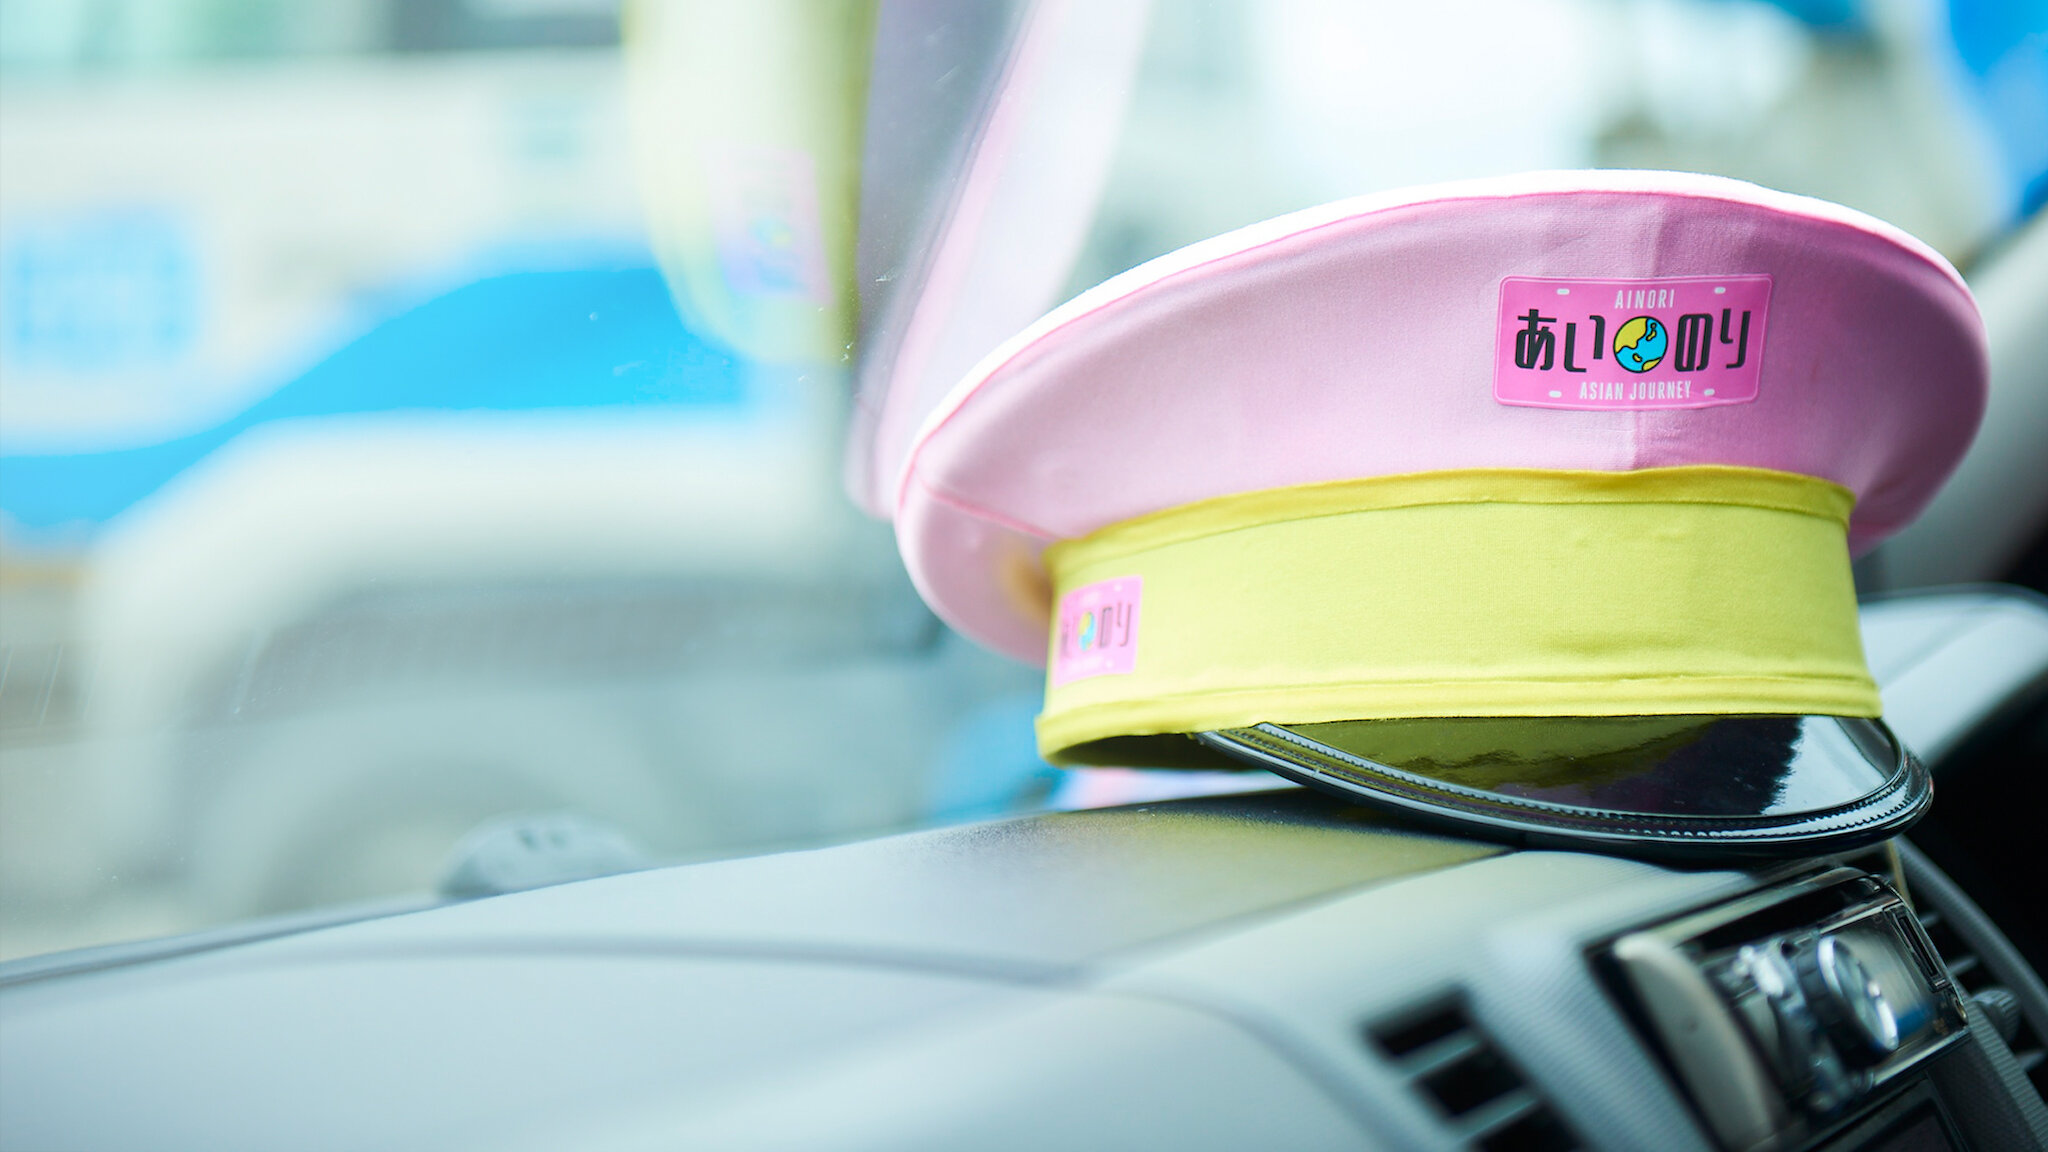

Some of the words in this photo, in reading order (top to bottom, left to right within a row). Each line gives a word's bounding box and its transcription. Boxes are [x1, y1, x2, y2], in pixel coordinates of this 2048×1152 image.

[1614, 289, 1675, 309] AINORI
[1579, 381, 1624, 400] ASIAN
[1629, 380, 1692, 400] JOURNEY
